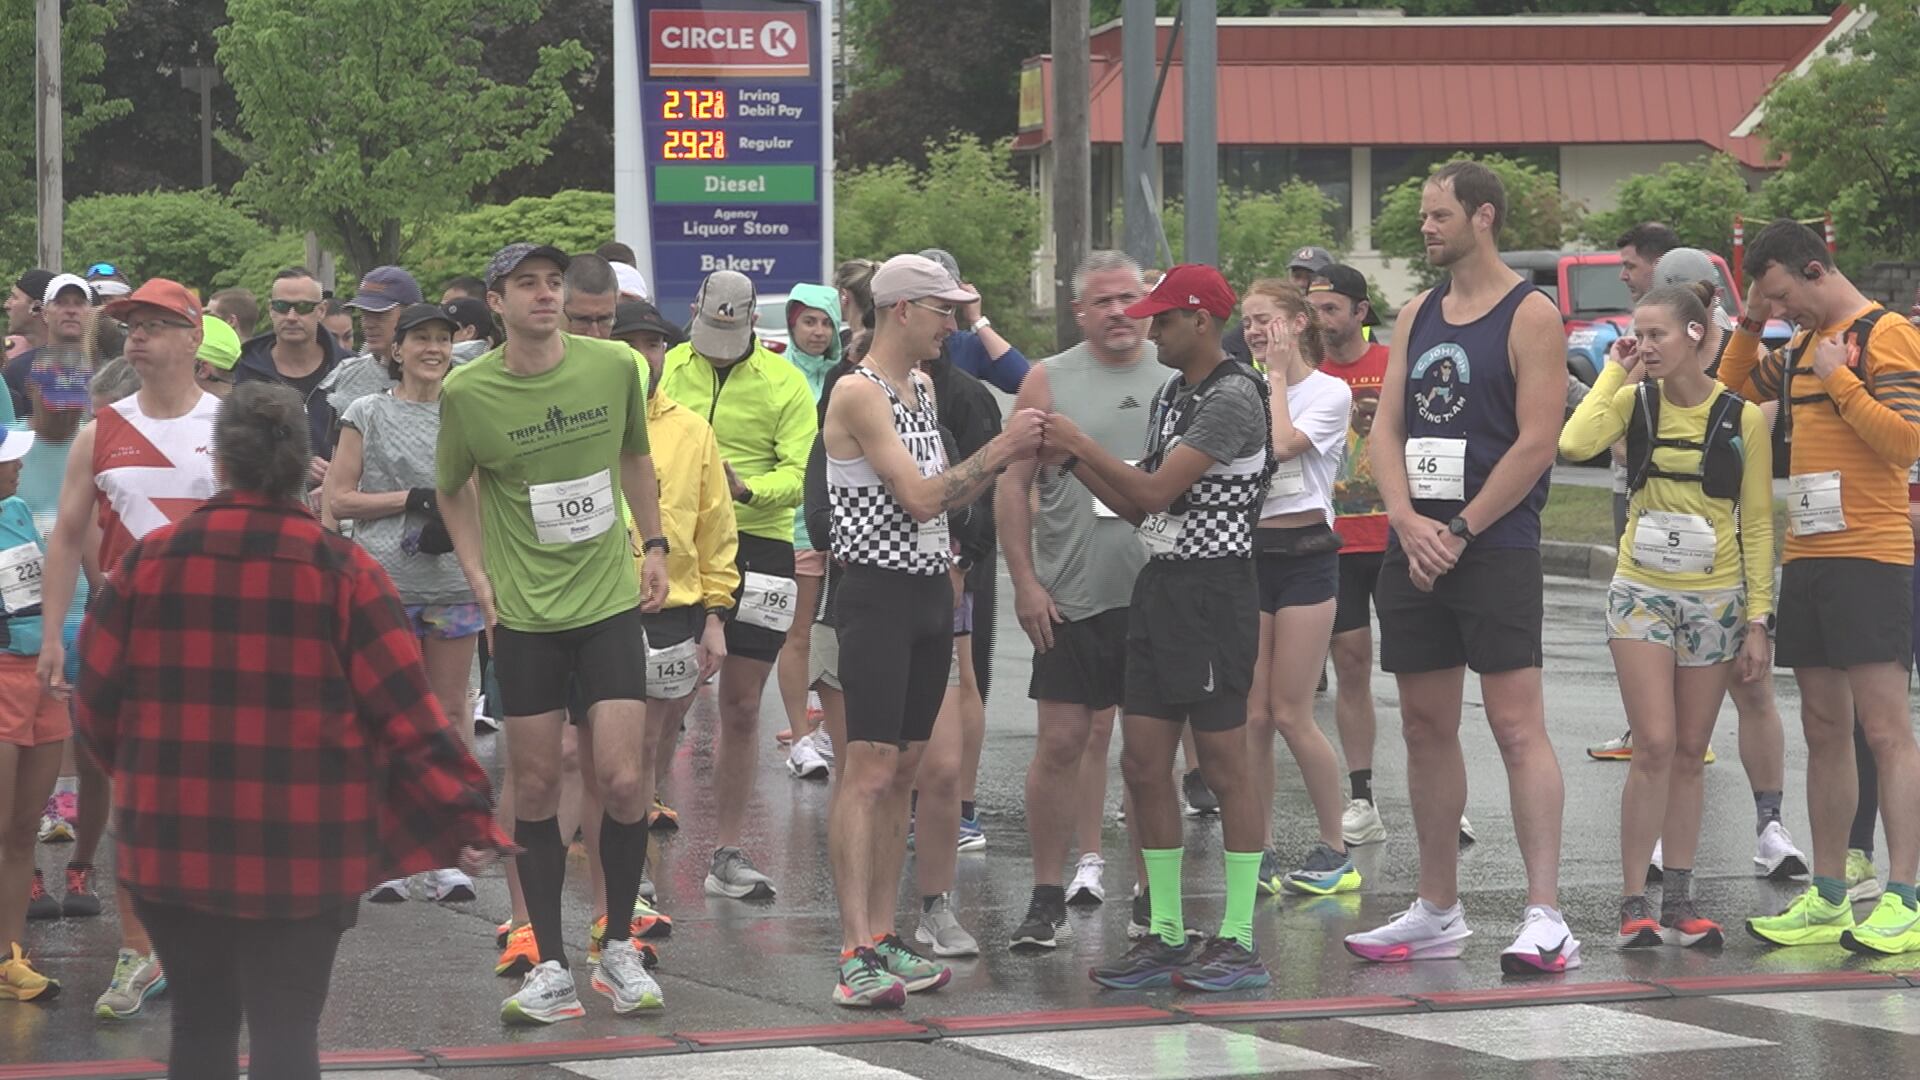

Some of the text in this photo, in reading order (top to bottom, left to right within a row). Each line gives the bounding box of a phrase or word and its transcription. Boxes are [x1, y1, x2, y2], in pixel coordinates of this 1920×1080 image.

[661, 25, 795, 52] CIRCLE K
[739, 89, 780, 104] Irving
[739, 104, 803, 119] Debit Pay
[739, 137, 793, 150] Regular
[704, 175, 766, 193] Diesel
[714, 209, 758, 221] Agency
[683, 221, 789, 237] Liquor Store
[700, 254, 776, 275] Bakery
[506, 419, 555, 441] TRIPLE
[560, 405, 609, 427] THREAT
[1417, 457, 1437, 473] 46
[556, 496, 595, 518] 108
[1800, 493, 1810, 509] 4
[1667, 531, 1681, 547] 5
[15, 560, 41, 581] 223
[762, 591, 788, 609] 196
[656, 660, 686, 678] 143
